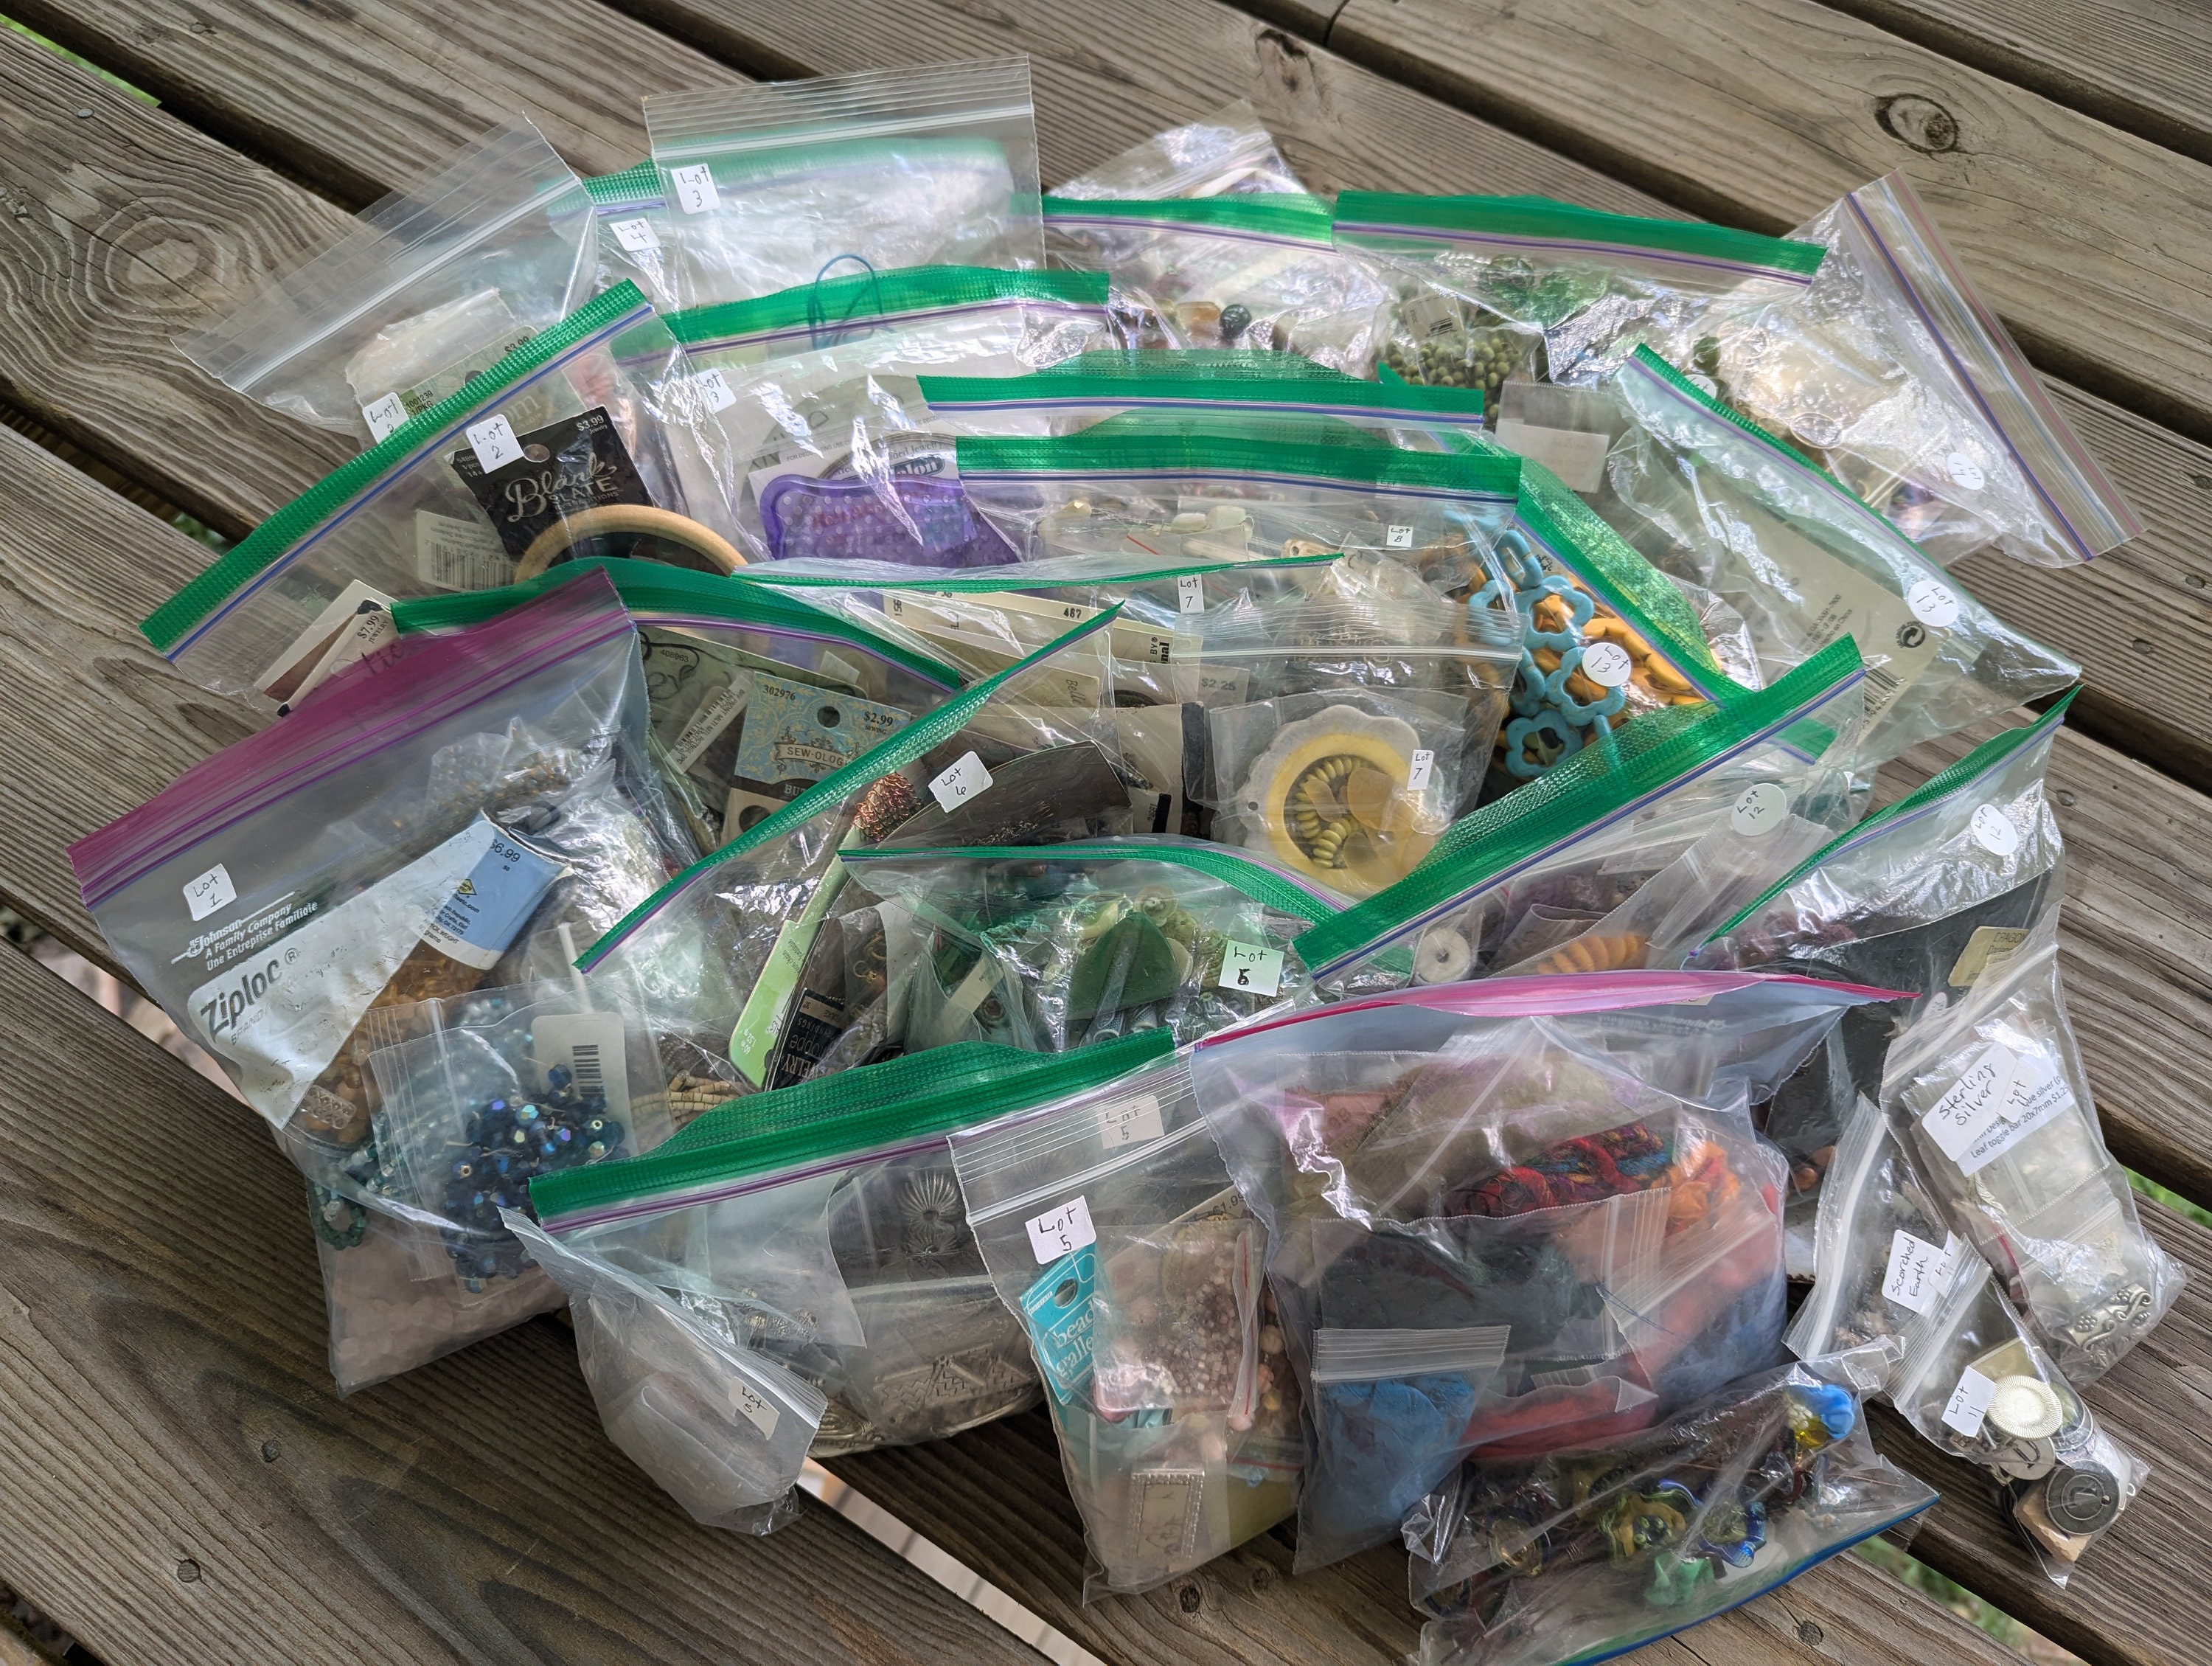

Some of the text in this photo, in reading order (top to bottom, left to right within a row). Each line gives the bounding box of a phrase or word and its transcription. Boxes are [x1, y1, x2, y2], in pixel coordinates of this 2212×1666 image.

[680, 166, 709, 185] Lot
[692, 190, 703, 208] 3
[618, 221, 644, 232] Lot
[630, 232, 647, 243] 4
[504, 336, 529, 355] $399
[702, 373, 721, 389] ot
[369, 399, 399, 423] Lot
[576, 415, 605, 431] $3.99
[473, 422, 504, 445] Lot
[491, 445, 504, 460] 2
[505, 452, 618, 523] Blank
[552, 476, 618, 505] SLATE
[1180, 577, 1198, 588] Lot
[1186, 596, 1193, 608] 7
[1916, 595, 1935, 612] 13
[1931, 587, 1954, 605] Lot
[357, 615, 380, 639] $7.99
[369, 619, 389, 645] JEWELRY
[661, 649, 689, 662] 408963
[1604, 646, 1629, 670] Lot
[1590, 657, 1611, 673] 13
[763, 684, 796, 701] 302976
[1065, 678, 1086, 705] Belle
[1201, 678, 1236, 691] $2.25
[863, 711, 894, 726] $2.99
[865, 725, 887, 735] SEWING
[1415, 752, 1430, 761] Lot
[941, 768, 961, 785] Lot
[1413, 768, 1423, 780] 7
[956, 785, 966, 795] 6
[1736, 790, 1759, 813] Lot
[1748, 806, 1765, 819] 12
[193, 873, 218, 898] Lot
[210, 893, 223, 908] 1
[187, 919, 243, 958] Johnson
[205, 903, 293, 959] A Family Company
[424, 929, 442, 943] grams
[439, 928, 459, 944] WEIGHT
[206, 954, 225, 971] Une
[226, 929, 274, 960] Entreprise
[1234, 946, 1267, 962] Lot
[200, 959, 283, 1044] Ziploc
[1938, 1063, 1996, 1120] Sterling
[2007, 1080, 2026, 1105] Lot
[2036, 1082, 2053, 1098] silver
[1105, 1105, 1141, 1123] Lot
[1121, 1125, 1130, 1140] 5
[1970, 1142, 1989, 1159] Leaf
[1988, 1129, 2010, 1148] toggle
[2009, 1120, 2021, 1132] bar
[2021, 1100, 2053, 1123] 20x7mm
[1038, 1207, 1077, 1233] Lot
[1060, 1235, 1072, 1252] 5
[1891, 1237, 1916, 1296] Scorched
[1909, 1256, 1928, 1297] Earth
[742, 1386, 768, 1411] Lot
[1949, 1385, 1970, 1415] Lot
[742, 1403, 753, 1413] 5
[1968, 1406, 1985, 1417] 11
